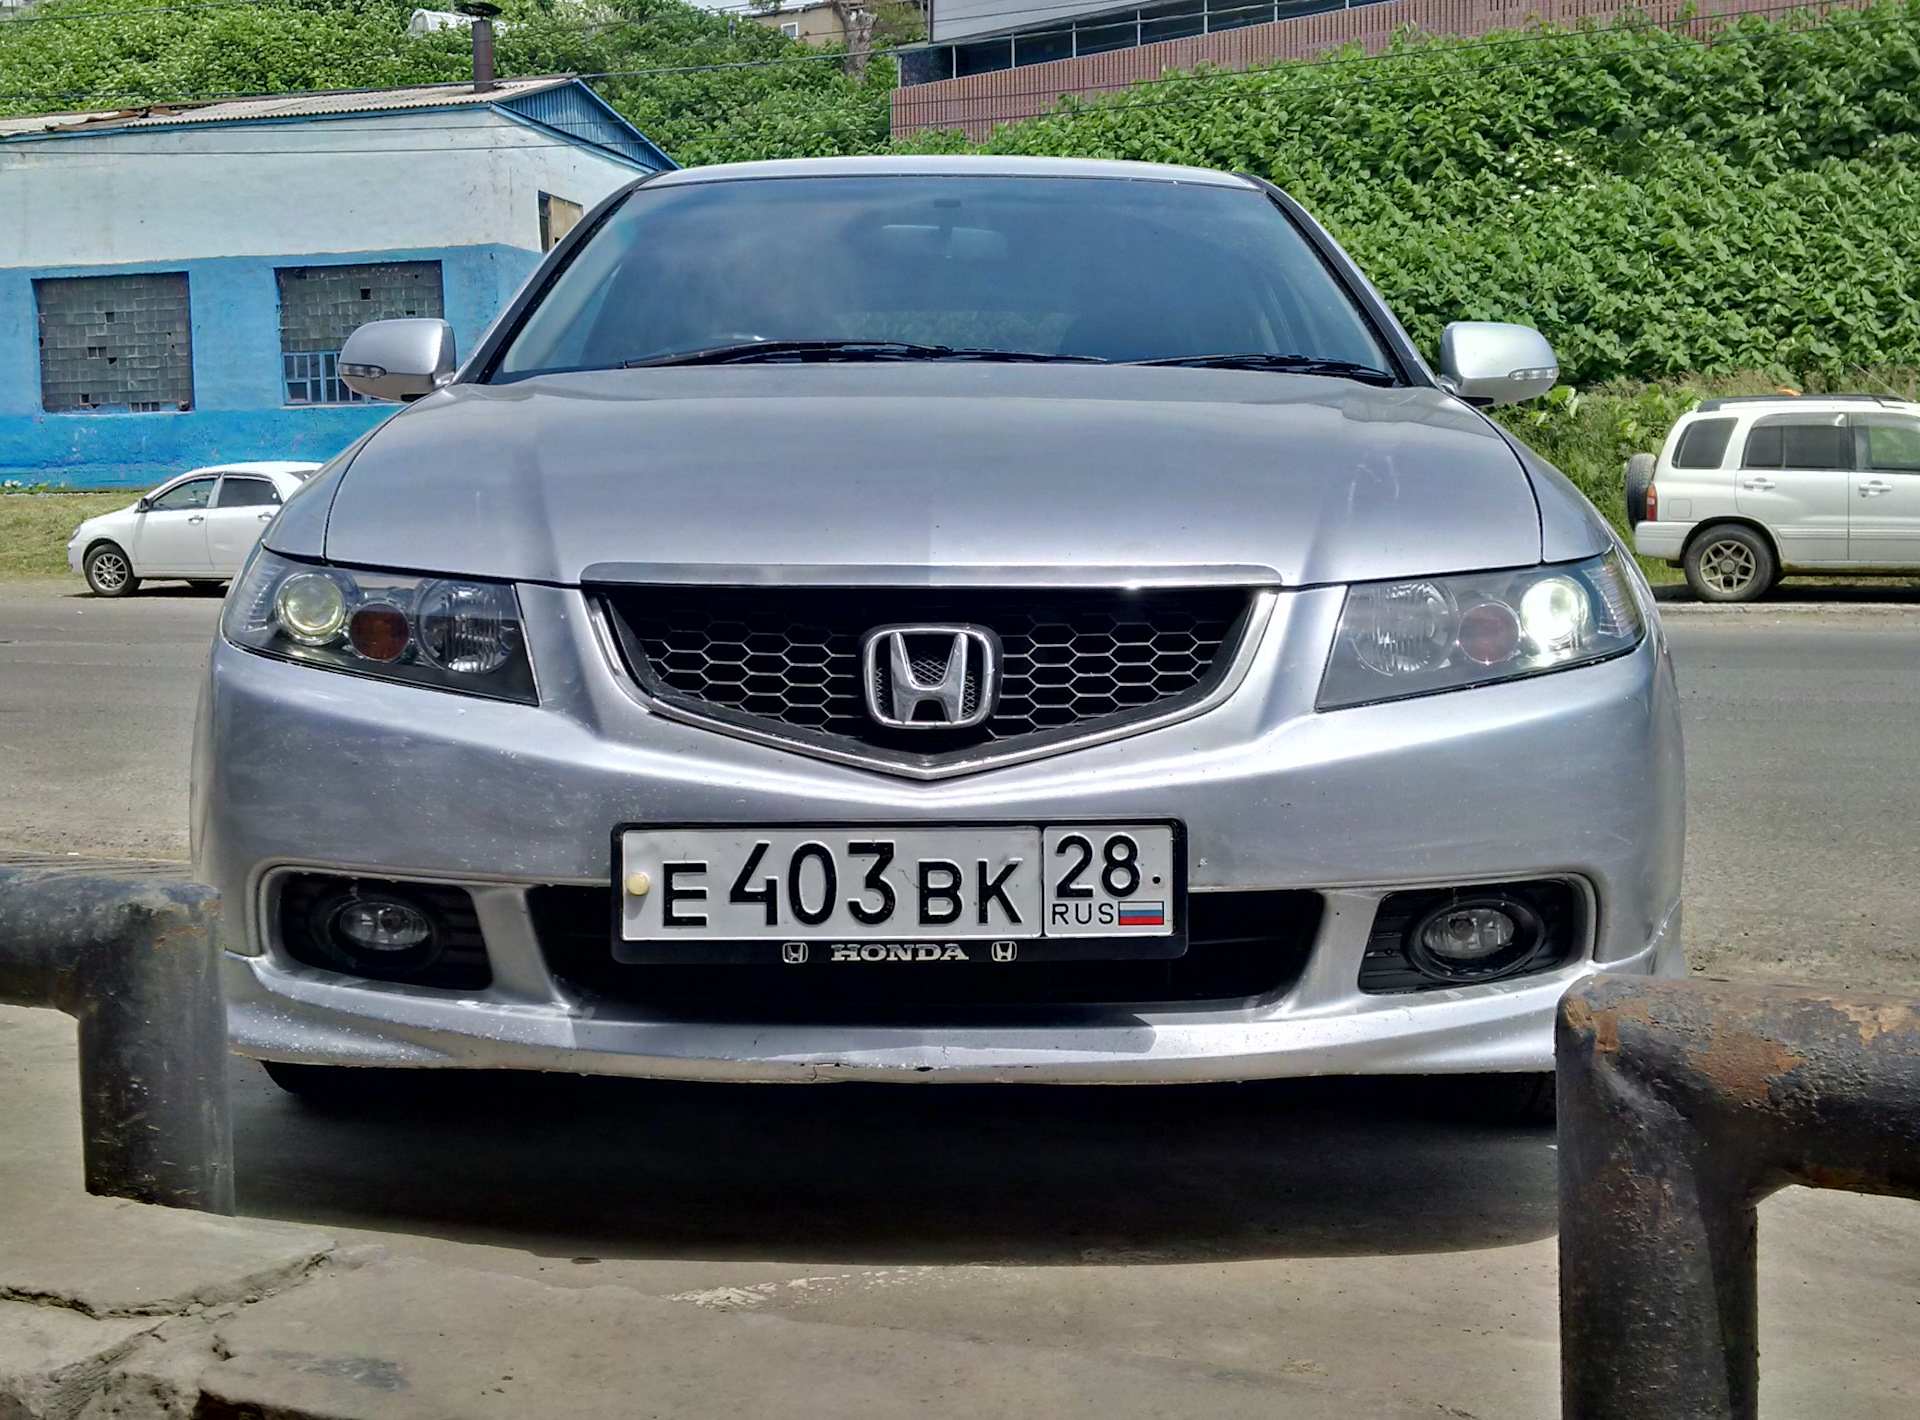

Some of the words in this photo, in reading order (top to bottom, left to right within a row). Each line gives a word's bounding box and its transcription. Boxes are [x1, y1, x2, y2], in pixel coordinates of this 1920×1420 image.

[1056, 834, 1141, 898] 28
[1051, 902, 1115, 925] RUS
[830, 943, 970, 962] HONDA
